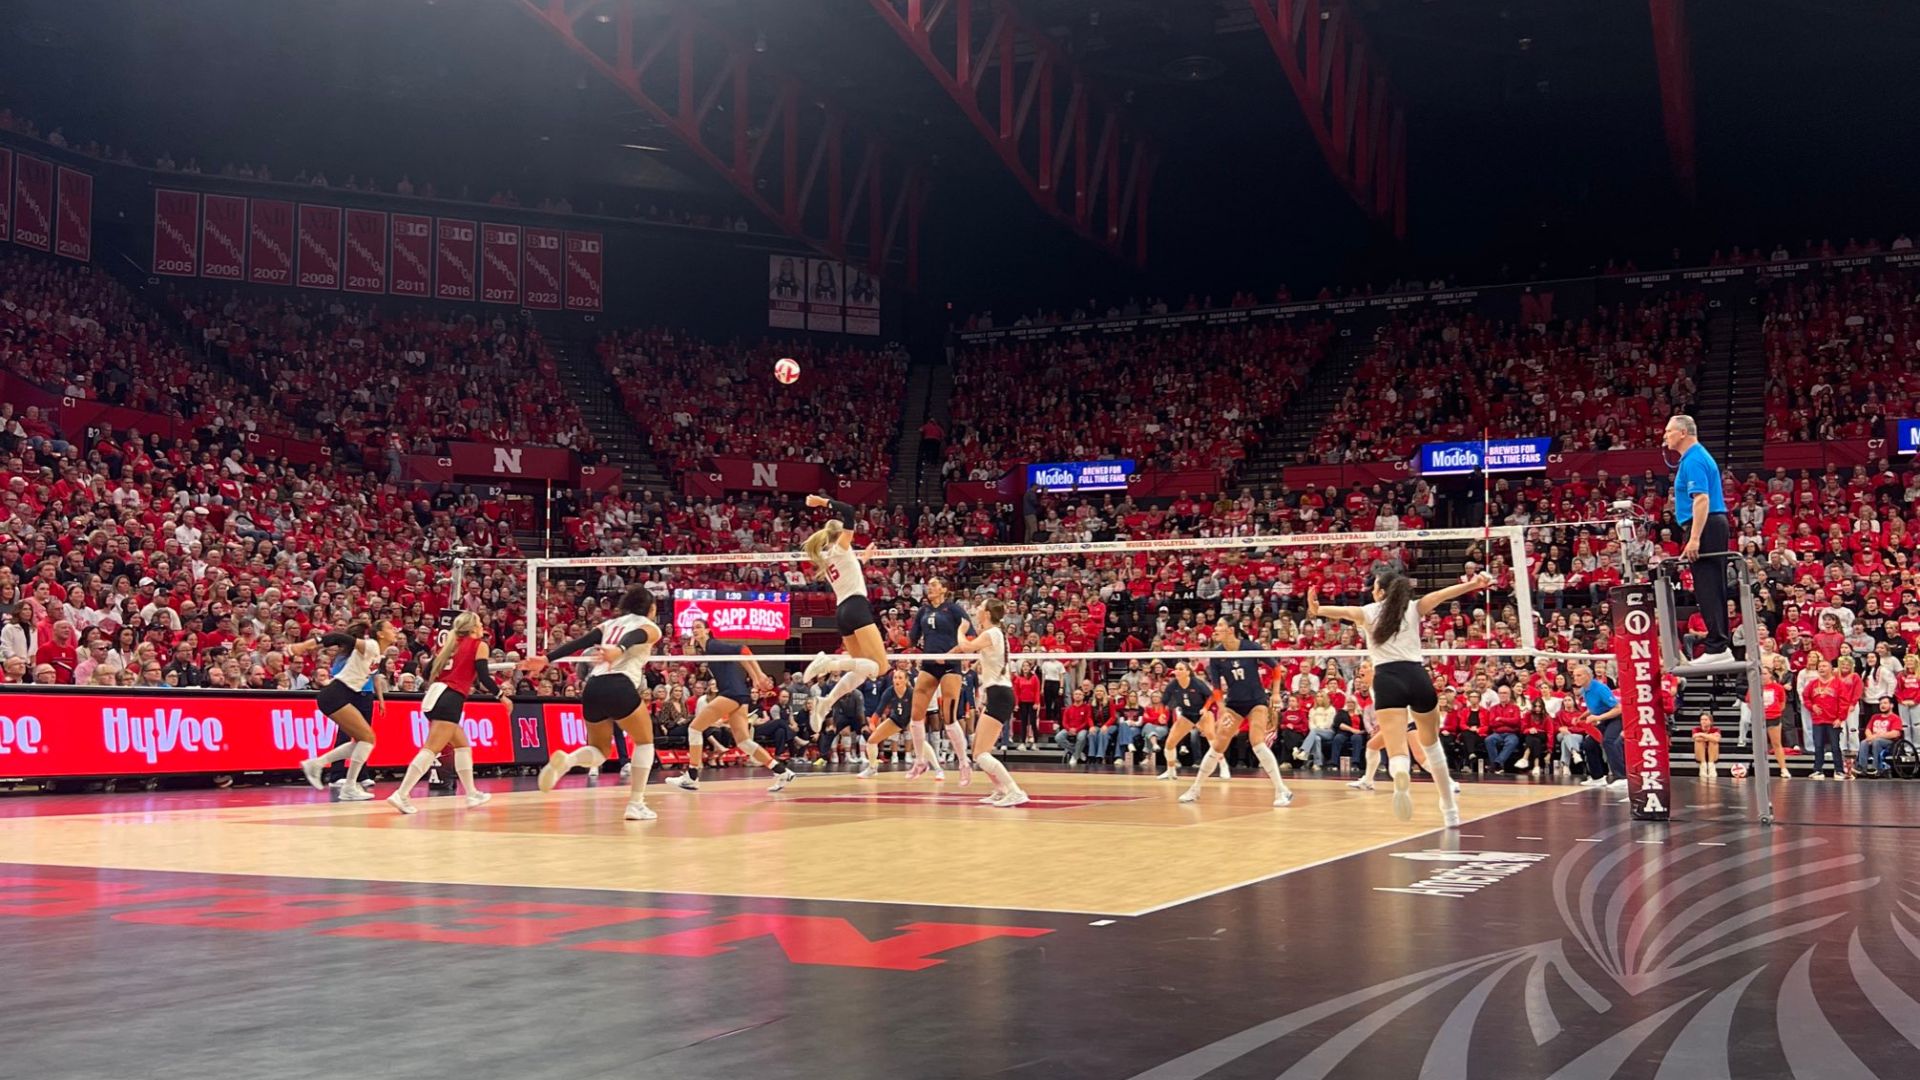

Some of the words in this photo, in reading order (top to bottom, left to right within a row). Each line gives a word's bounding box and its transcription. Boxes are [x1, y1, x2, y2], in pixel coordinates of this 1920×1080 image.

[17, 229, 47, 246] 2002
[159, 260, 192, 272] 2005
[206, 263, 240, 276] 2006
[253, 267, 287, 280] 2007
[302, 272, 335, 285] 2008
[349, 276, 381, 288] 2010
[397, 280, 425, 291] 2011
[440, 285, 471, 296] 2016
[486, 288, 515, 299] 2017
[528, 292, 558, 303] 2023
[568, 296, 599, 307] 2024
[63, 397, 75, 408] C1
[249, 432, 259, 443] C2
[1867, 438, 1885, 448] C7
[1489, 445, 1519, 455] BREWED
[1521, 444, 1536, 454] FOR
[438, 457, 452, 467] C3
[494, 447, 522, 473] N
[1432, 449, 1479, 467] Modelo
[1485, 456, 1503, 465] FULL
[1503, 455, 1521, 464] TIME
[1521, 453, 1541, 463] FANS
[1548, 454, 1563, 464] C6
[581, 465, 595, 475] C3
[1394, 461, 1408, 471] C6
[710, 473, 722, 482] C4
[752, 462, 778, 487] N
[1035, 469, 1074, 485] Modelo
[1079, 475, 1095, 484] FULL
[1096, 474, 1111, 483] TIME
[1112, 473, 1126, 482] FANS
[1129, 474, 1142, 483] C5
[985, 479, 997, 489] C5
[1290, 534, 1319, 542] HUSKER
[1321, 531, 1367, 540] VOLLEYBALL
[999, 545, 1040, 553] VOLLEYBALL
[1125, 541, 1151, 549] HUSKER
[1153, 539, 1197, 547] VOLLEYBALL
[1183, 591, 1194, 600] A4
[713, 607, 748, 628] SAPP
[926, 612, 936, 629] 9
[605, 625, 625, 645] 11
[1231, 667, 1246, 681] 19
[1629, 639, 1664, 813] NEBRASKA
[102, 708, 223, 764] HyVee
[518, 717, 541, 748] N
